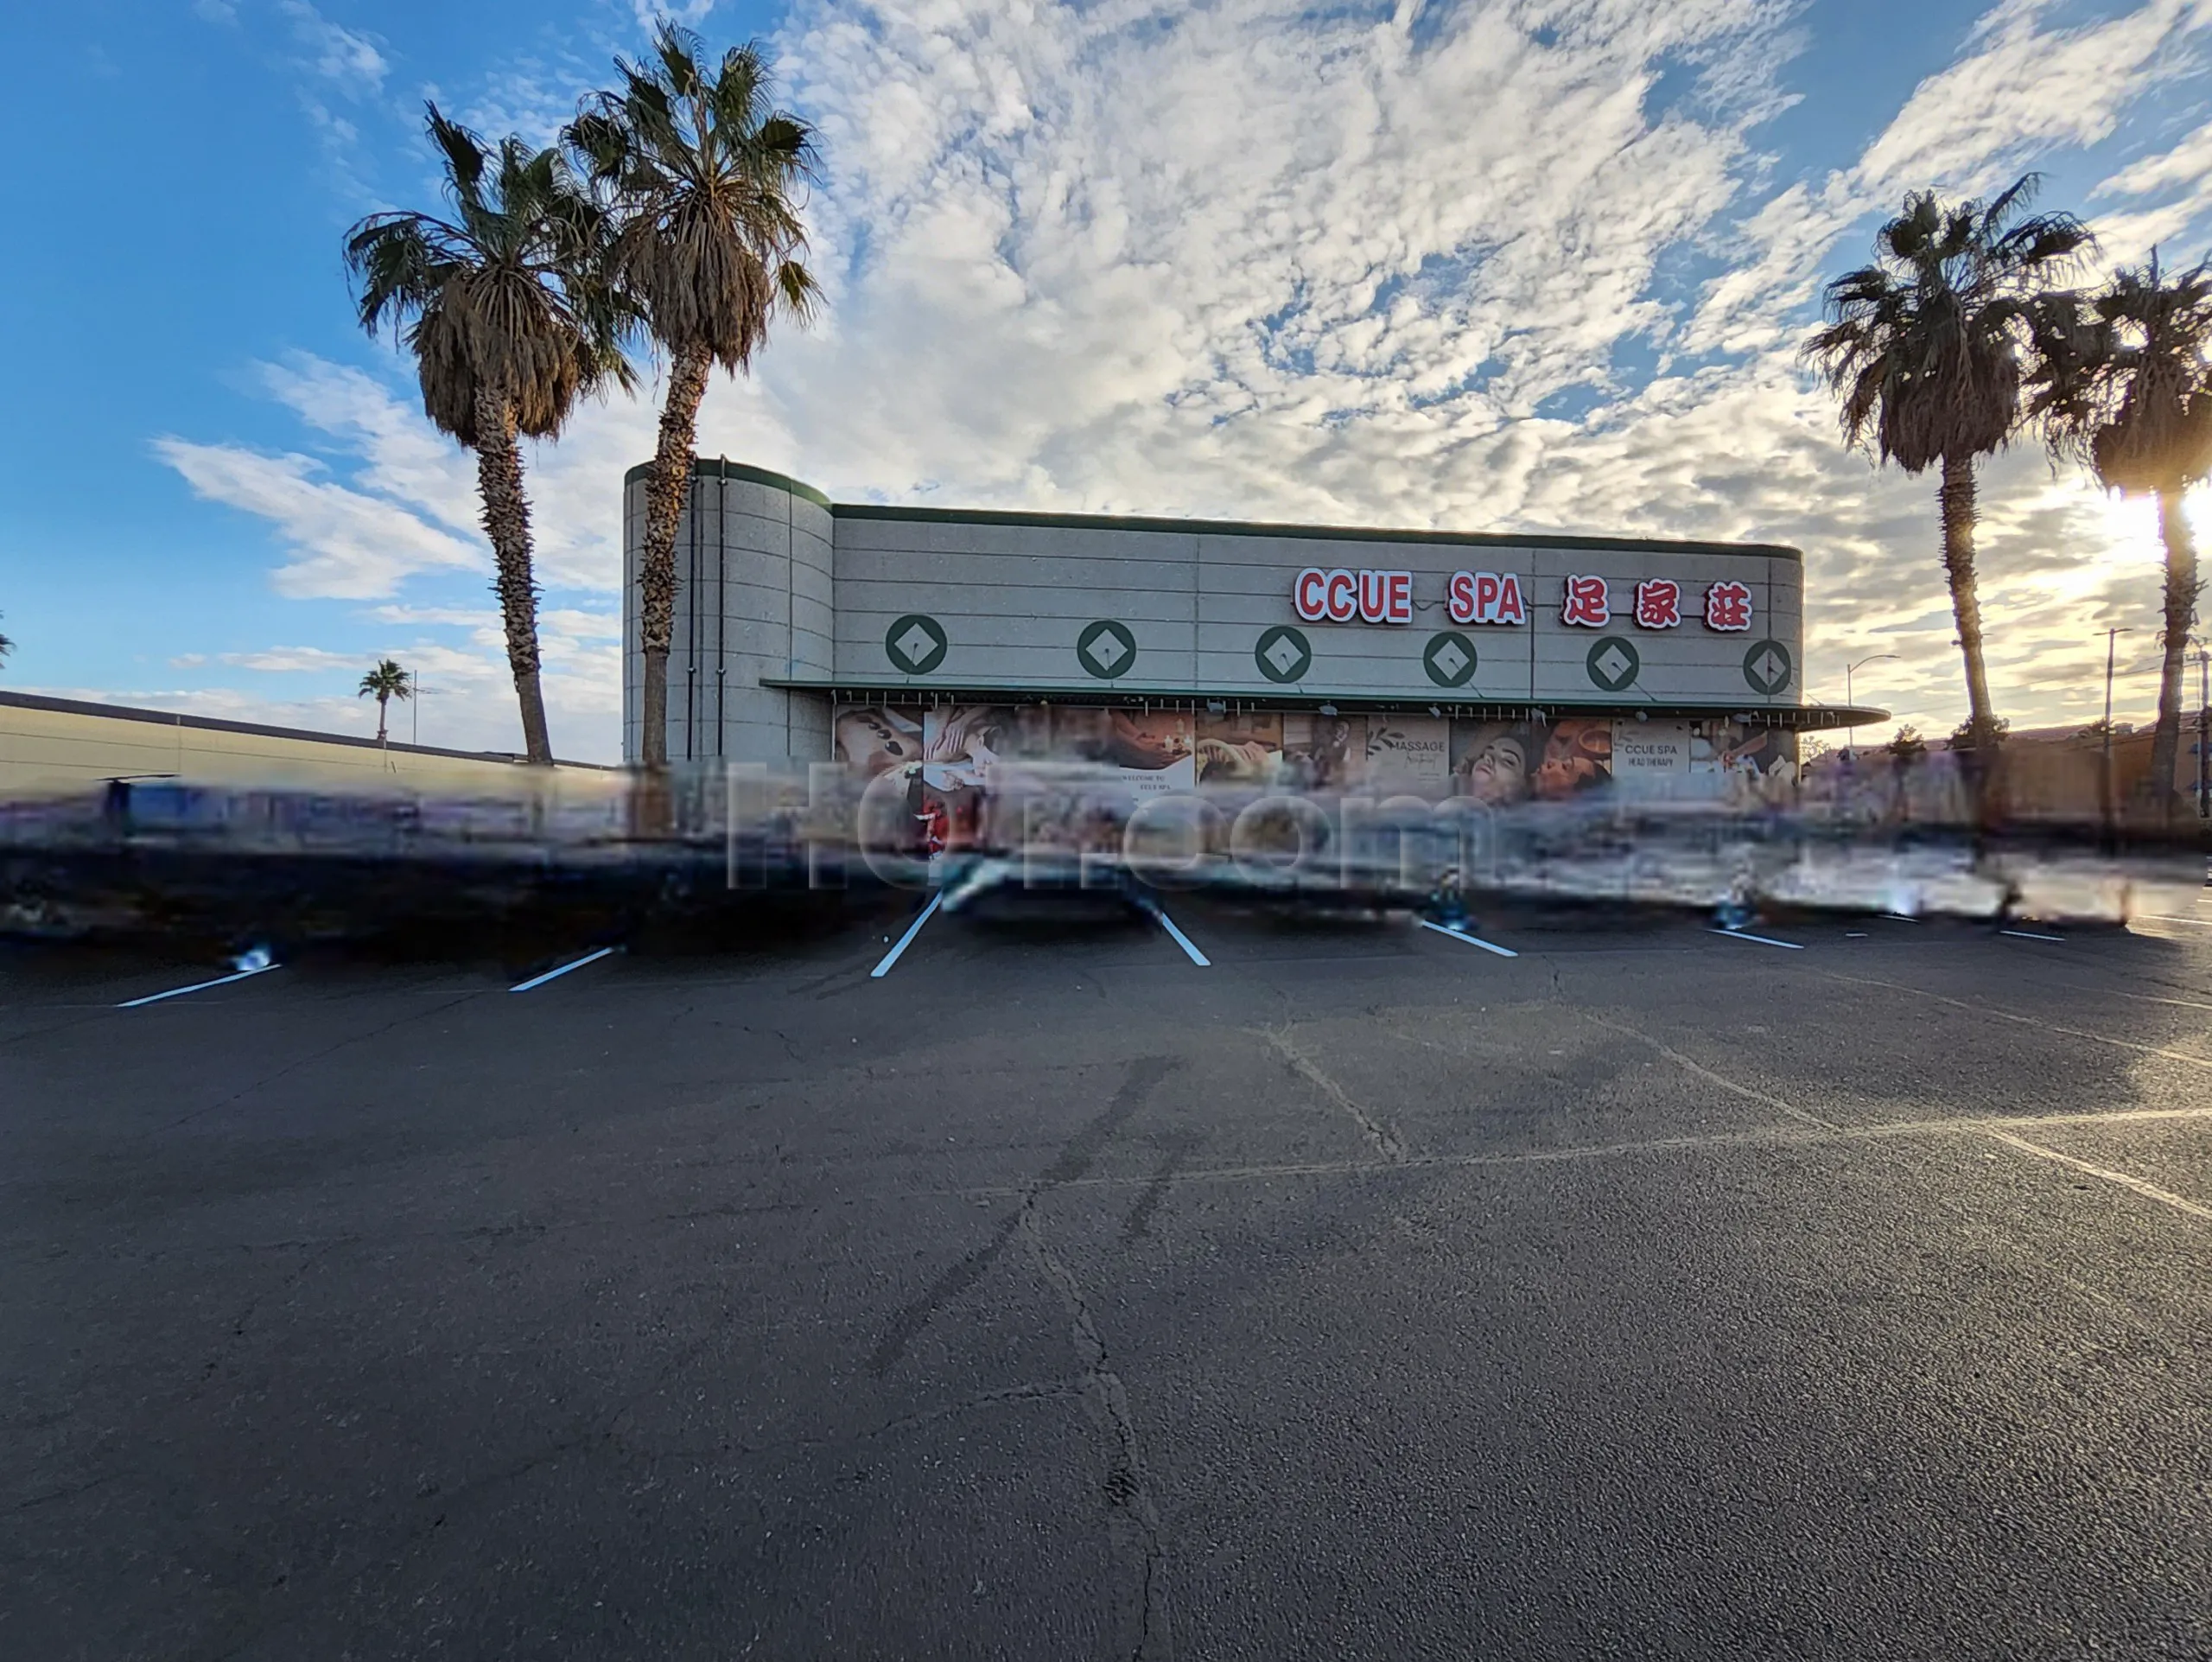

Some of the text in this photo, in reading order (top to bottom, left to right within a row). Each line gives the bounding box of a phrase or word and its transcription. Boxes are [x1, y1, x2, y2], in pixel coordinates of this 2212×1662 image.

[1295, 568, 1526, 624] CCUE SPA
[1390, 741, 1446, 752] MASSAGE
[1624, 744, 1678, 755] CCUE SPA
[1628, 757, 1645, 767] HEAD
